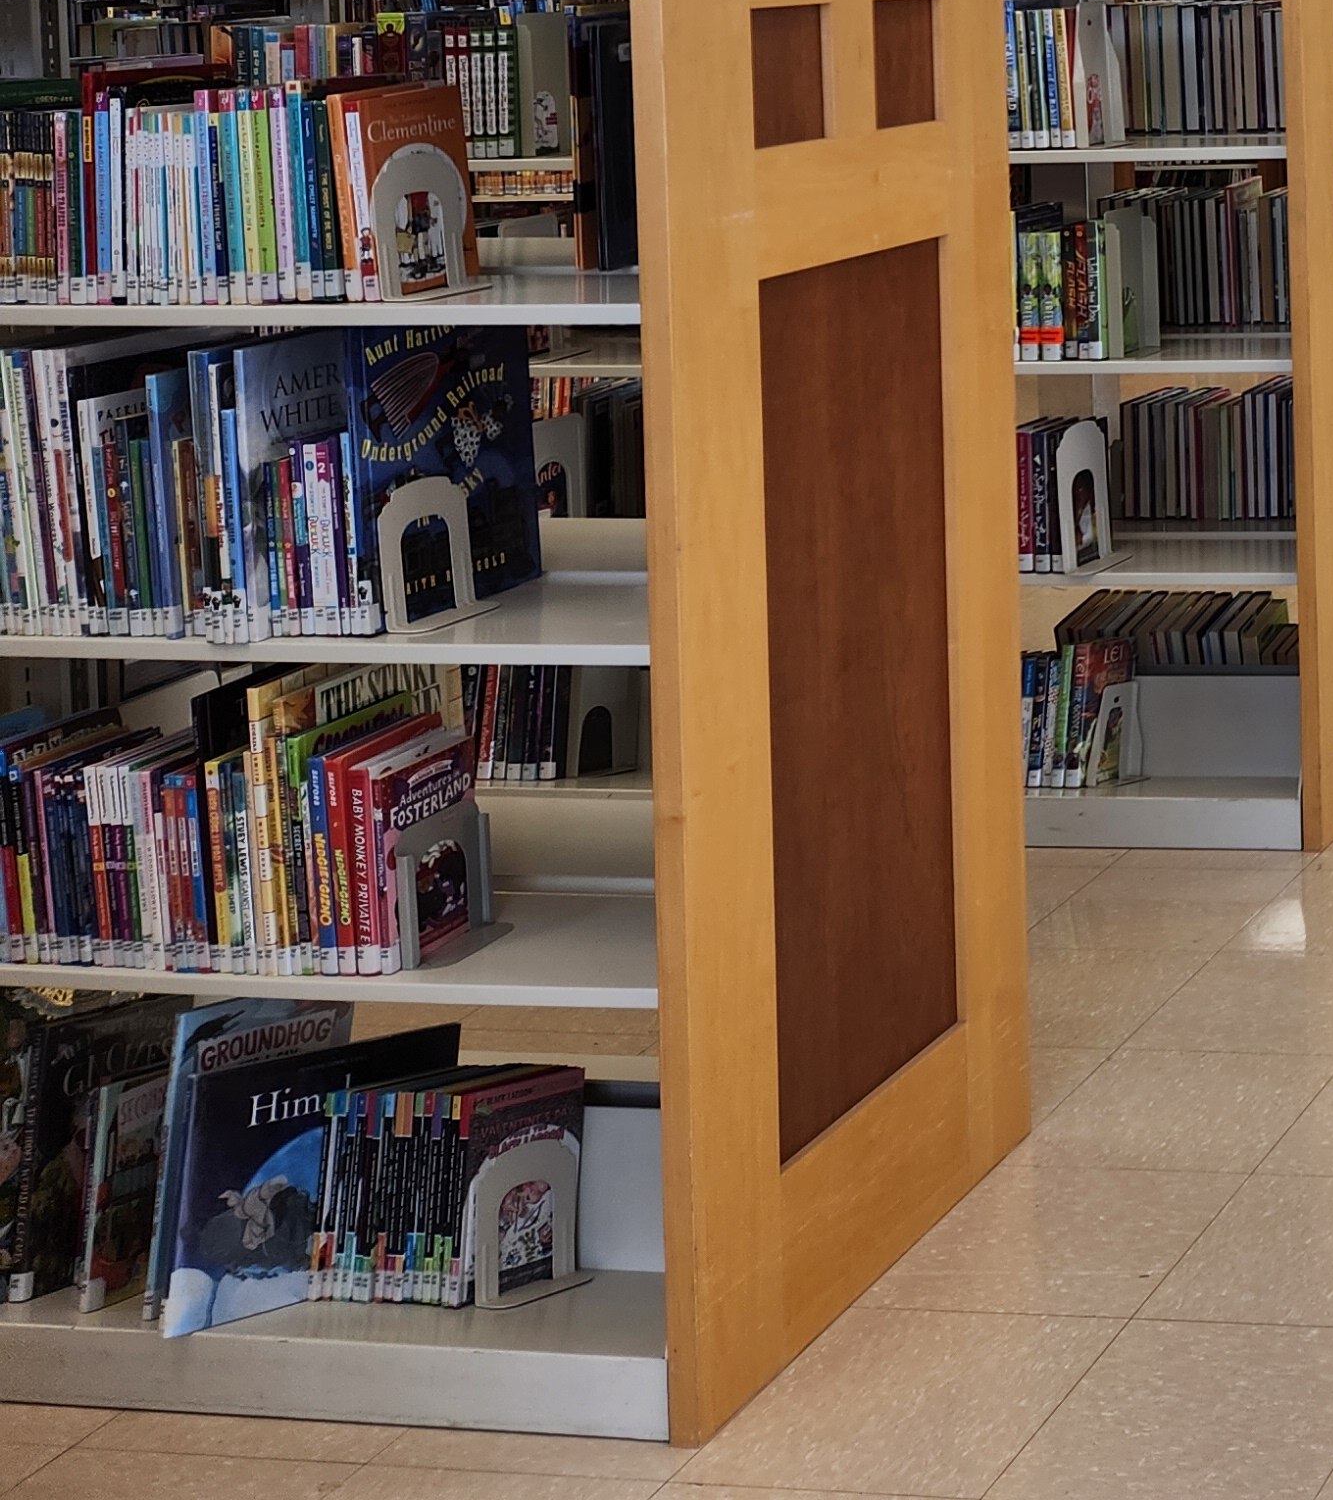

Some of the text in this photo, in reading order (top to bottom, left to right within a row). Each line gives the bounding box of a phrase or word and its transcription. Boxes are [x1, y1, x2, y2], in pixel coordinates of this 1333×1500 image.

[367, 114, 456, 144] Clementine
[1066, 260, 1076, 308] FLASH
[364, 334, 399, 366] Aunt
[273, 362, 342, 398] AMER
[260, 394, 340, 433] WHITE
[361, 362, 504, 462] Underground Railroad
[317, 462, 326, 474] 2
[406, 574, 437, 596] AITH
[1104, 644, 1124, 664] LEI
[311, 770, 321, 806] SELFORS
[327, 771, 337, 807] SELFORS
[351, 788, 364, 822] BABY
[390, 773, 472, 828] FOSTERLAND
[400, 773, 452, 807] Adventures
[236, 816, 246, 845] STUEY
[238, 848, 248, 877] LEWIS
[357, 883, 370, 931] PRIVATE
[201, 1018, 332, 1071] GROUNDHOG
